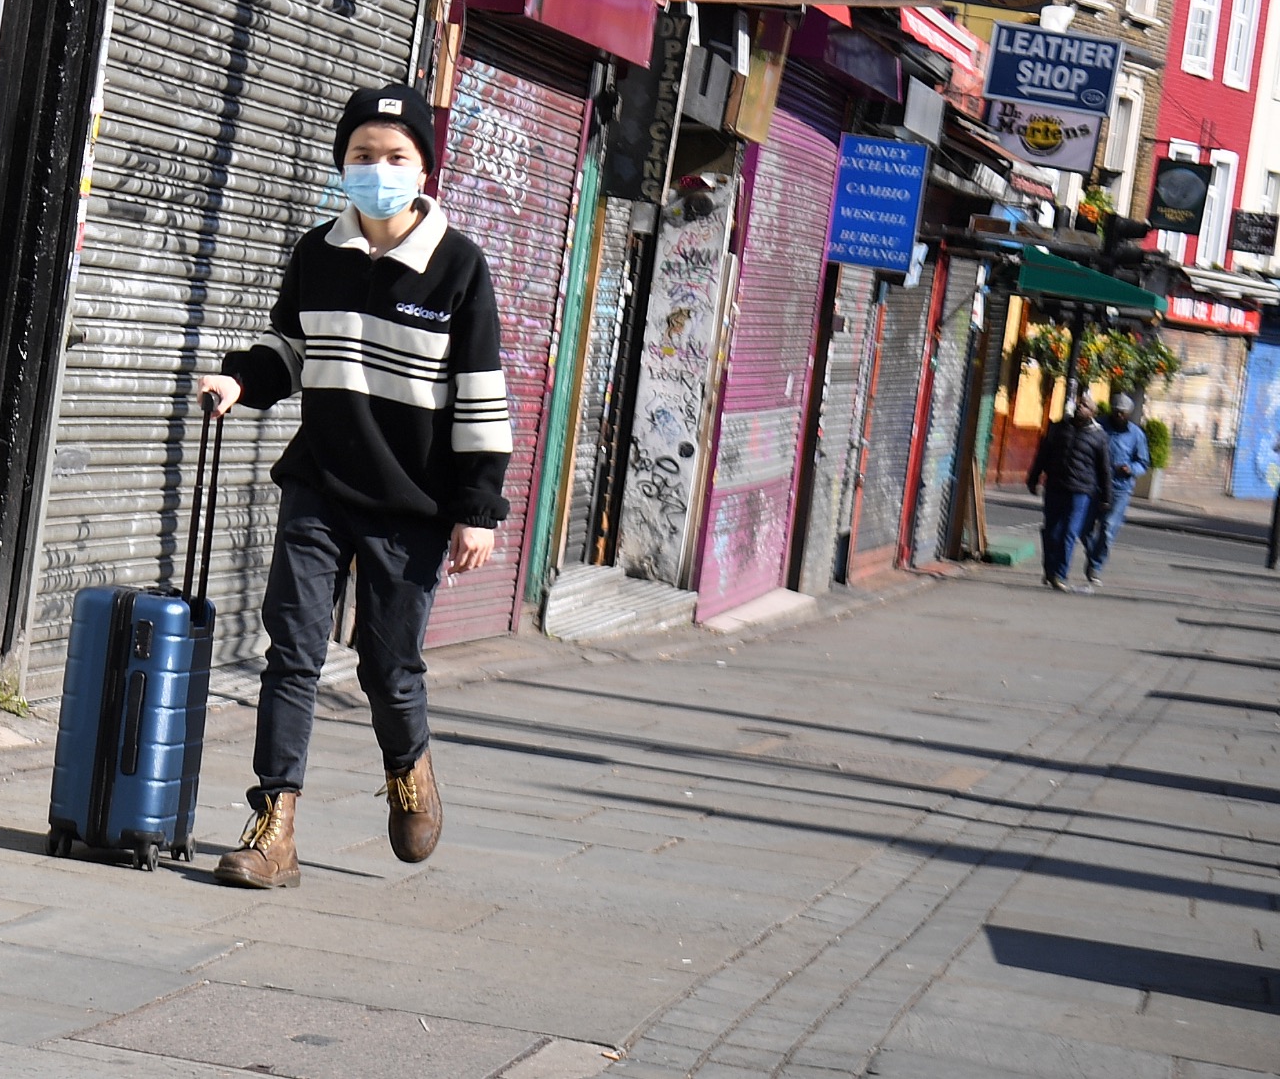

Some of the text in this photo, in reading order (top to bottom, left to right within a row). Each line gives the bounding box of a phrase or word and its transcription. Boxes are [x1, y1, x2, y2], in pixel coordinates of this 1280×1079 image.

[996, 28, 1116, 70] LEATHER
[1016, 60, 1090, 93] SHOP
[641, 39, 682, 206] PIERCING
[993, 117, 1091, 141] Martens
[855, 143, 912, 161] MONEY
[839, 156, 923, 178] EXCHANGE
[845, 182, 911, 202] CAMBIO
[840, 229, 900, 247] BUREAU
[827, 241, 909, 264] DE CHANGE
[395, 302, 435, 320] adidas
